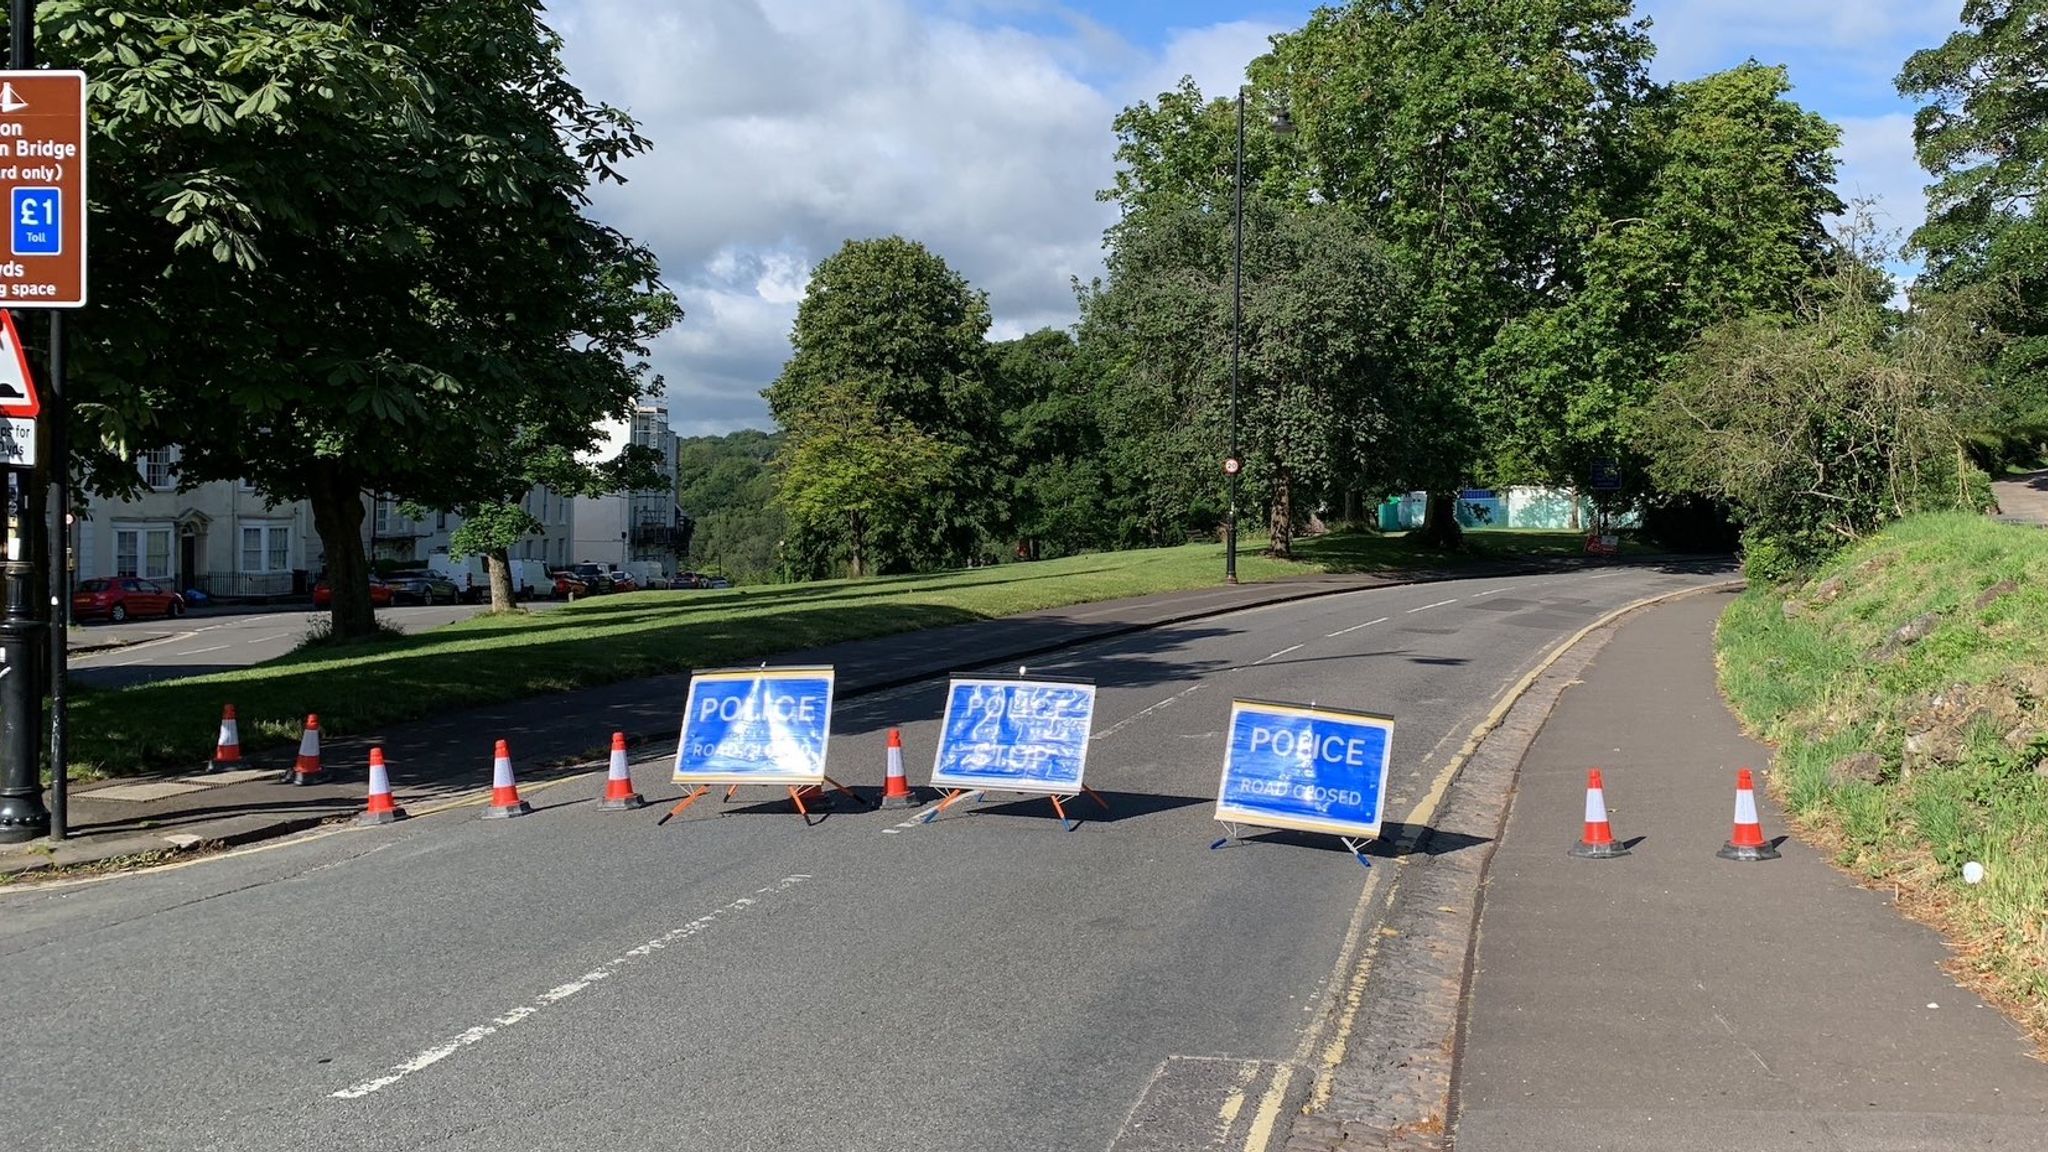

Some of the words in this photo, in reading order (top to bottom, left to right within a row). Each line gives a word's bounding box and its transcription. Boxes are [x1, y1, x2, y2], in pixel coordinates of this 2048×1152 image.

[0, 123, 22, 136] on
[16, 139, 76, 160] Bridge
[21, 163, 63, 182] only)
[20, 198, 53, 225] £1
[26, 232, 46, 243] Toll
[12, 284, 57, 298] space
[16, 425, 30, 438] for
[700, 695, 817, 722] POLICE
[692, 743, 739, 757] ROD
[1250, 727, 1366, 766] POLICE
[1240, 778, 1289, 796] ROAD
[1293, 784, 1362, 806] CLOSED
